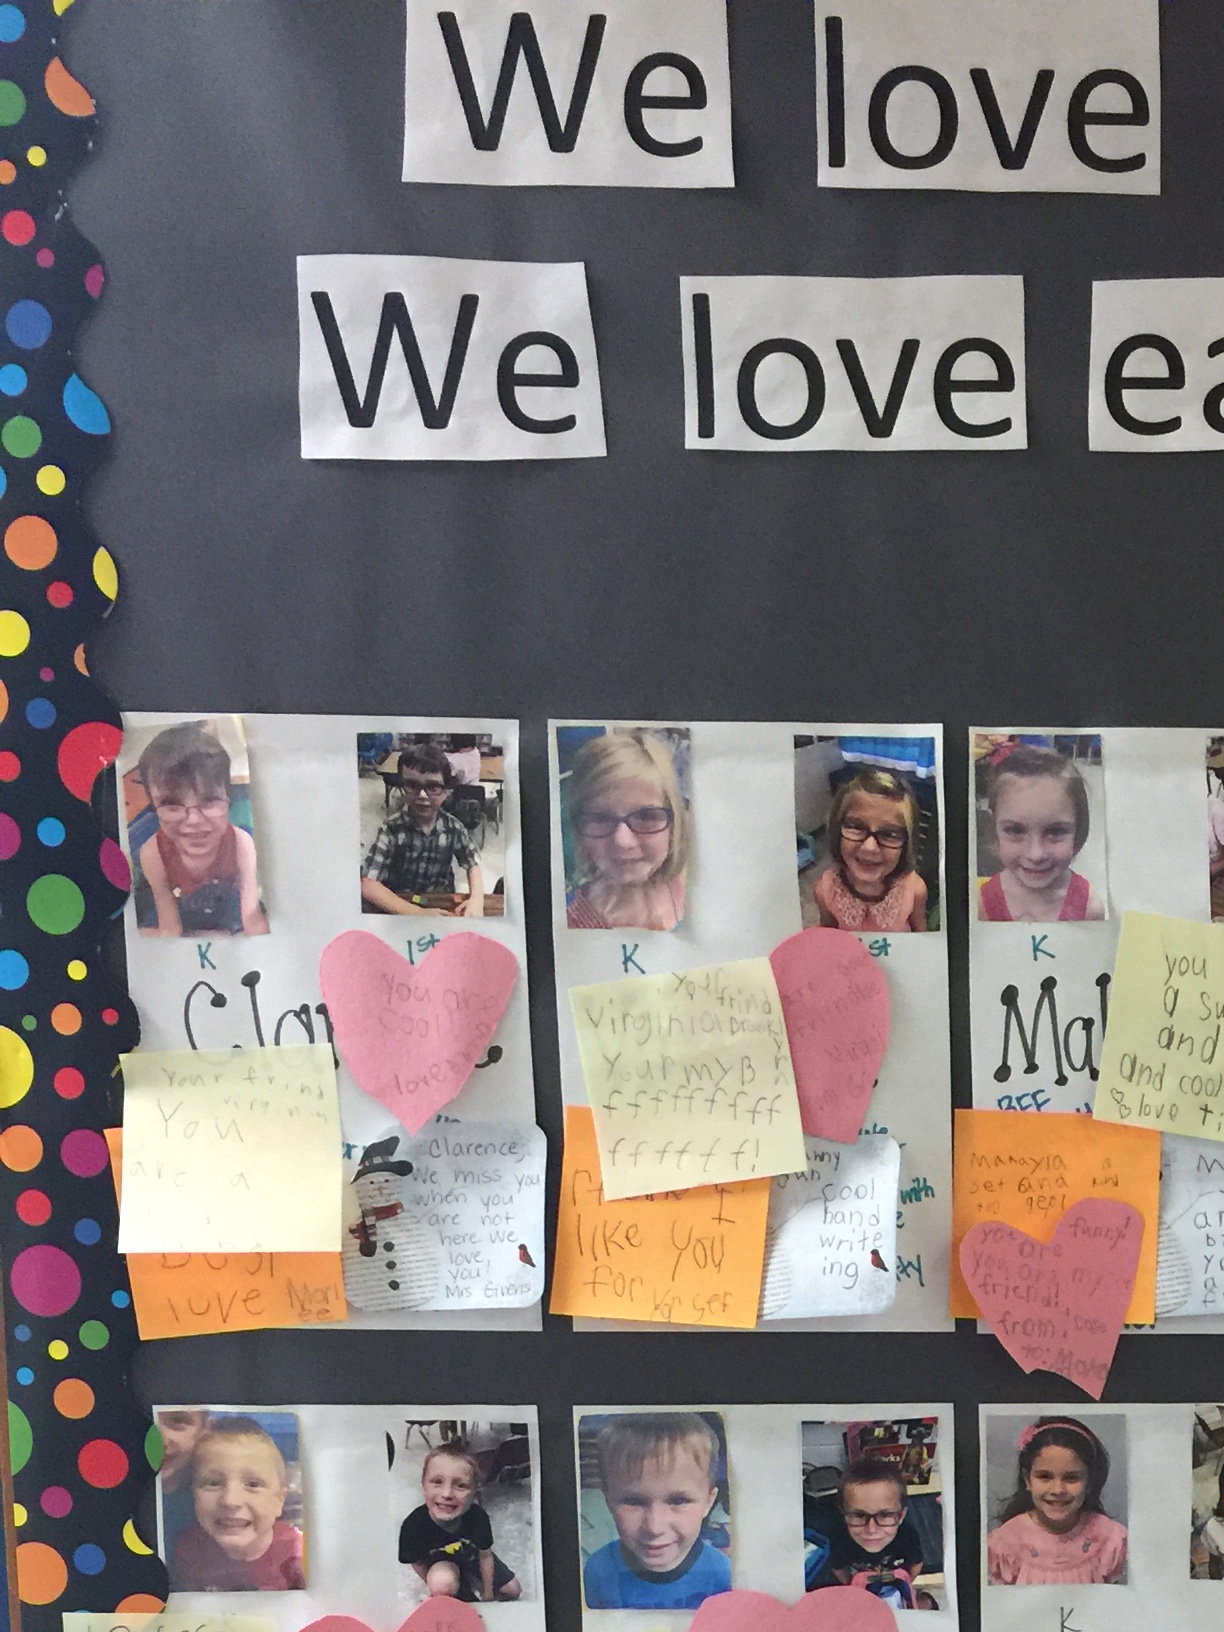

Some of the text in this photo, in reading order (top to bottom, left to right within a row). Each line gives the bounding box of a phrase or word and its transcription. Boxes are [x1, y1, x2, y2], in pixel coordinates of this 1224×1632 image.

[438, 12, 707, 157] We
[825, 16, 1149, 173] love
[311, 292, 579, 433] We
[693, 294, 1015, 439] love
[199, 943, 216, 970] K
[622, 943, 646, 974] K
[1031, 935, 1056, 961] K
[454, 1169, 502, 1186] miss
[481, 1192, 514, 1217] you
[429, 1210, 515, 1226] are not
